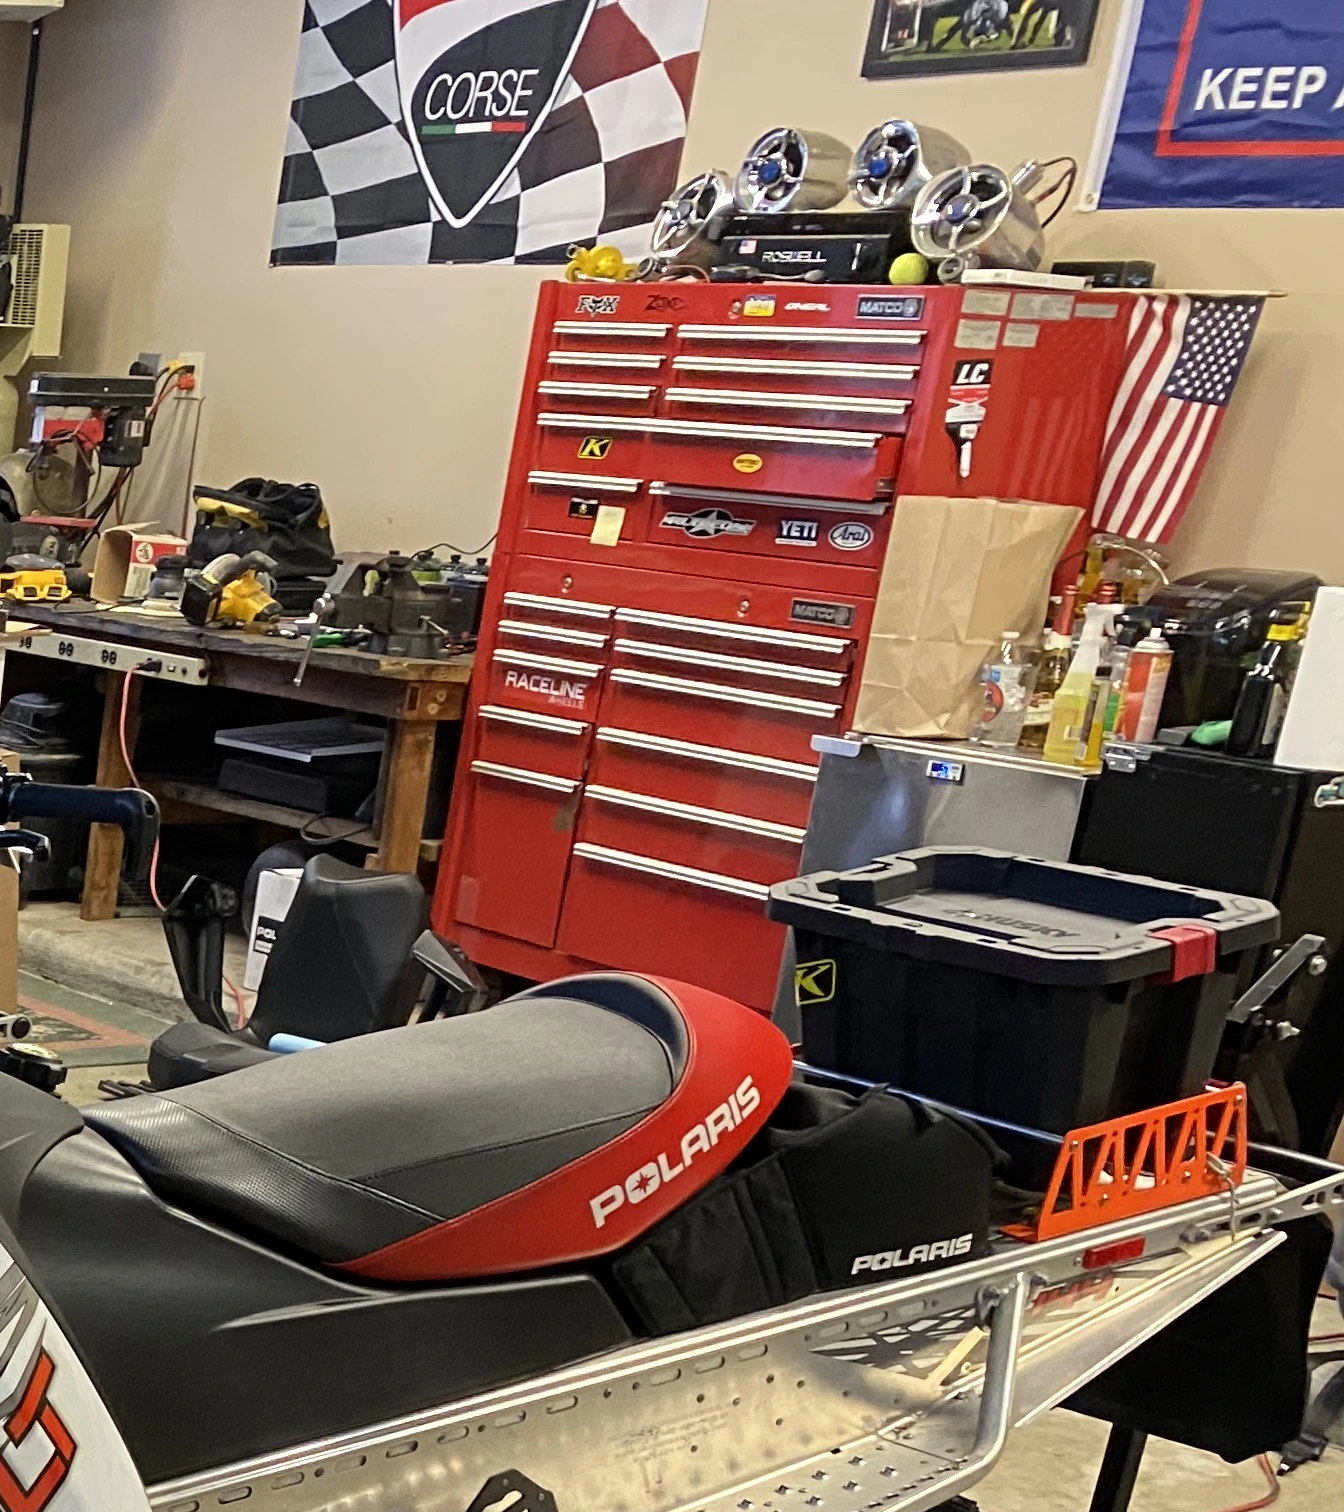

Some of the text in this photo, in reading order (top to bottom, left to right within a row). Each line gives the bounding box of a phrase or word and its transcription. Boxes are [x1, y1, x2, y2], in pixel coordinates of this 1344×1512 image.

[425, 68, 539, 120] CORSE
[1194, 65, 1328, 111] KEEP
[859, 300, 903, 314] MATCO
[955, 362, 990, 385] LC
[780, 520, 818, 540] YETI
[793, 603, 836, 620] MATCO
[504, 670, 588, 701] RACELINE
[588, 1074, 762, 1230] POLARIS
[850, 1232, 974, 1276] POLARIS
